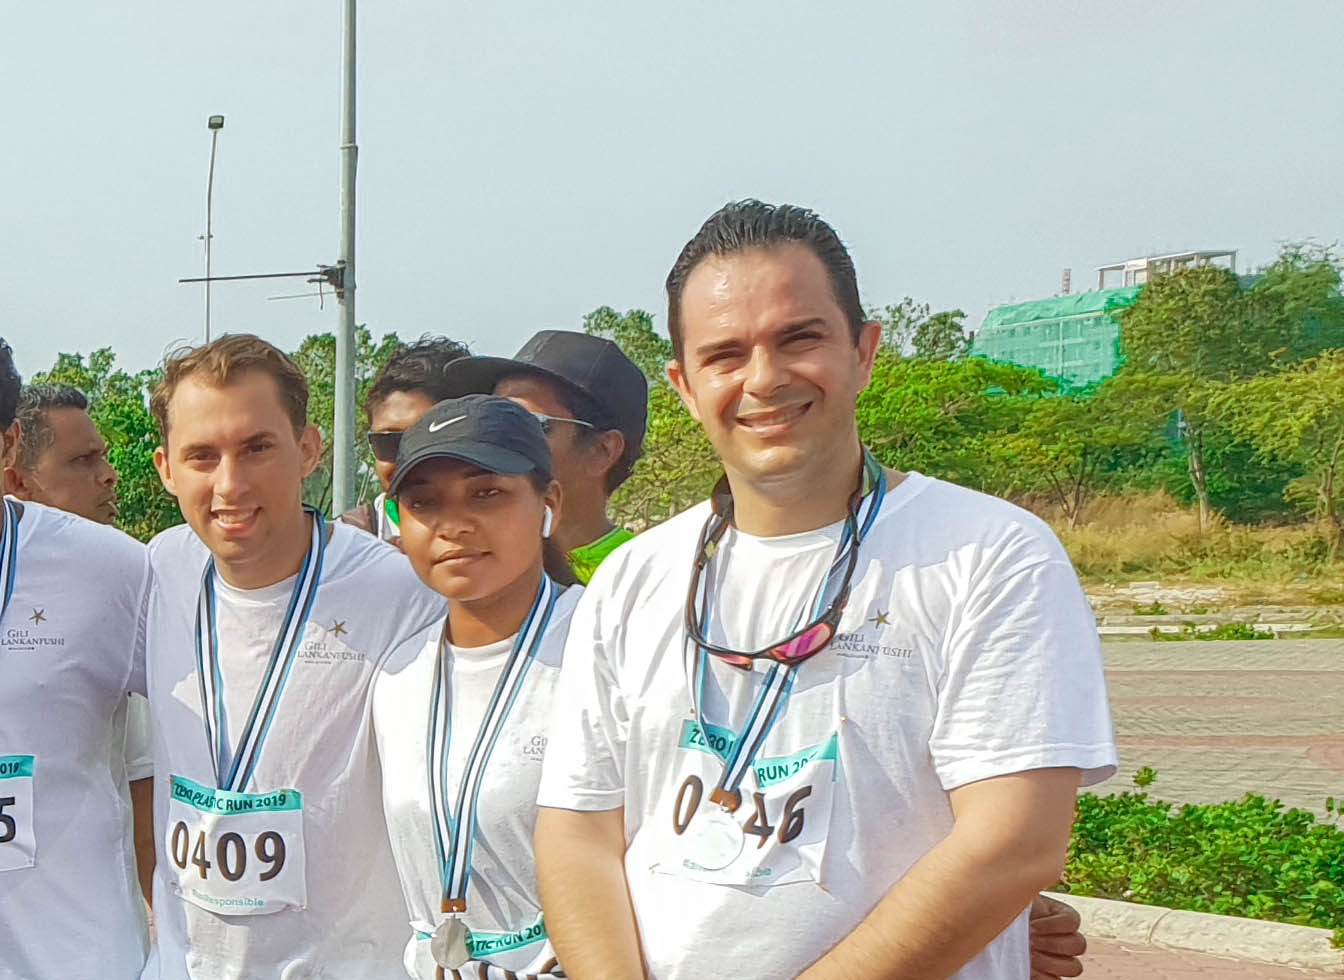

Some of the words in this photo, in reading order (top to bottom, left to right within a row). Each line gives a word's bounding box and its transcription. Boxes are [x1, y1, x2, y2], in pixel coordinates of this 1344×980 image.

[7, 628, 29, 639] GILI
[757, 764, 789, 783] RUN
[226, 799, 253, 811] RUN
[255, 793, 287, 808] 2019
[672, 774, 813, 850] 046
[171, 820, 287, 883] 0409
